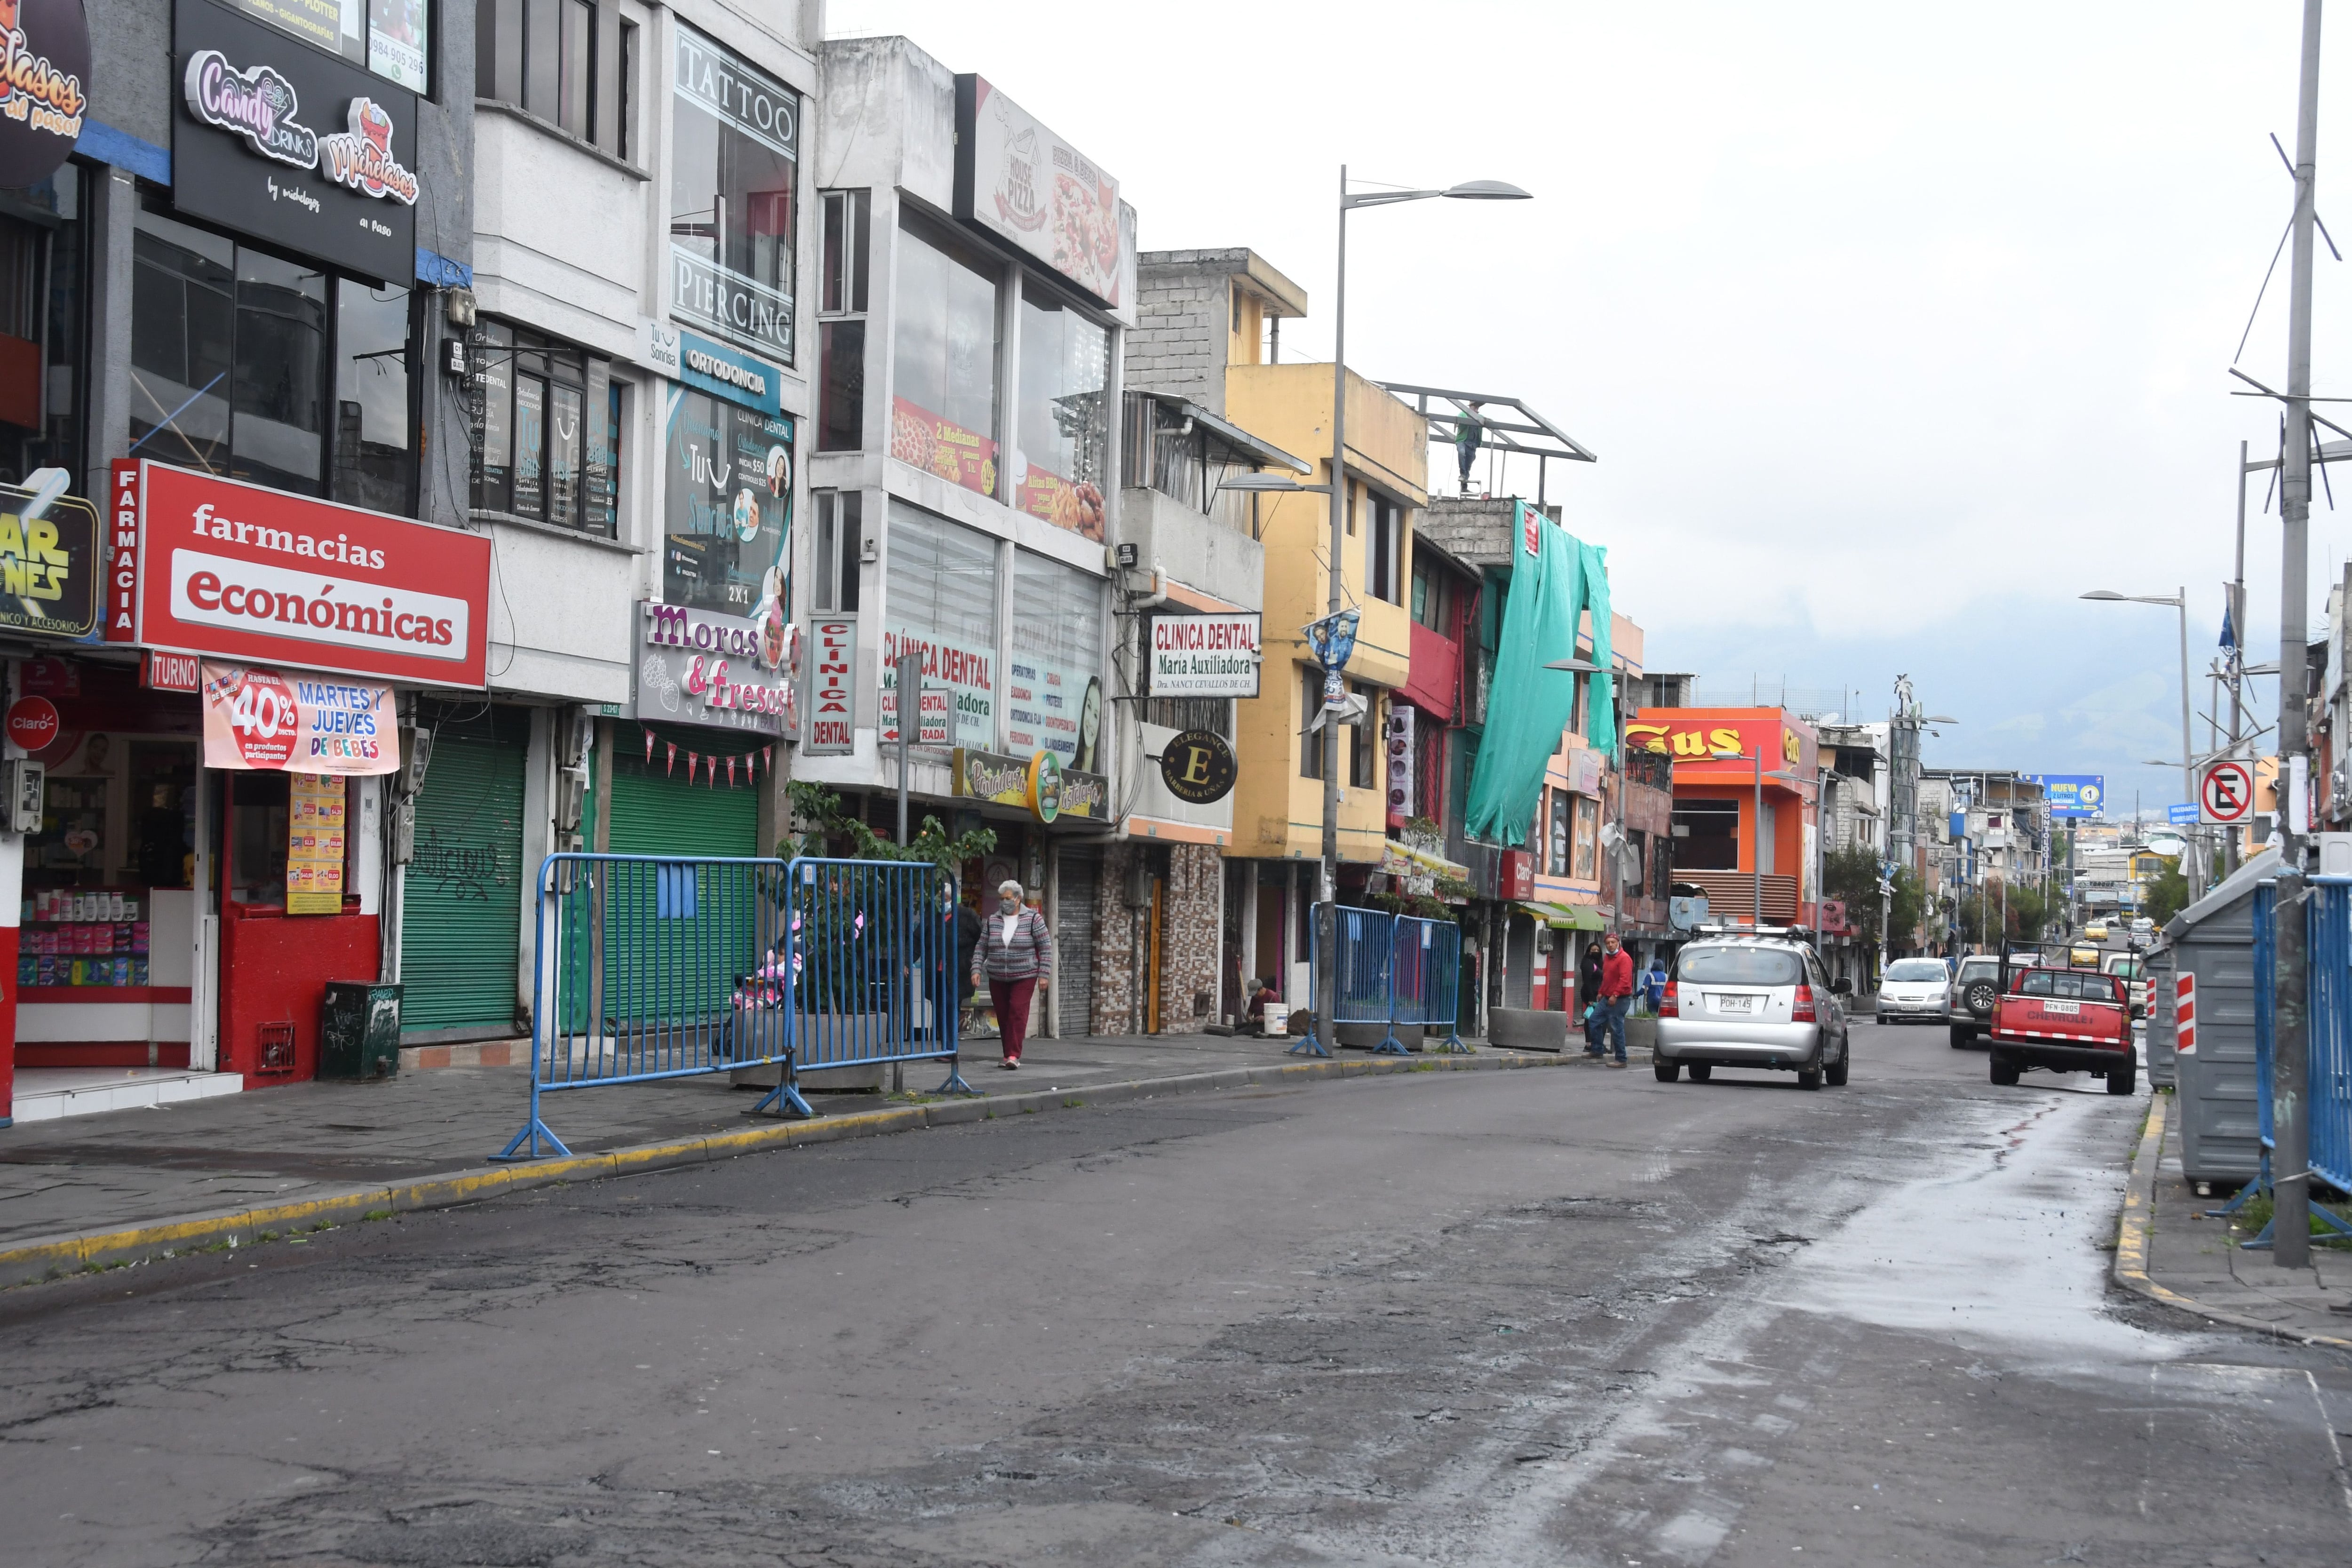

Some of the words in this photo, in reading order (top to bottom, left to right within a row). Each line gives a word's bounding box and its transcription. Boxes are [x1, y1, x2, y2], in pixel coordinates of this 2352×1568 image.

[390, 48, 406, 66] 905
[409, 56, 423, 75] 296
[203, 62, 274, 140] Candy
[681, 38, 792, 141] TATTOO
[271, 126, 312, 158] DRINKS
[330, 136, 416, 200] Michelasos
[1010, 153, 1032, 188] HOUSE
[1053, 145, 1073, 173] PIZZA
[1074, 156, 1079, 177] &
[1080, 160, 1097, 192] BEER
[268, 175, 278, 201] by
[1008, 177, 1035, 216] PIZZA
[678, 261, 790, 345] PIERCING
[651, 323, 660, 343] Tu
[651, 343, 675, 367] Sonrisa
[688, 349, 767, 396] ORTODONCIA
[520, 406, 539, 453] Tu
[765, 418, 789, 438] DENTAL
[937, 422, 942, 440] 2
[944, 426, 980, 448] Medianas
[690, 444, 705, 484] Tu
[739, 457, 752, 469] INICIAL
[753, 459, 764, 474] $50
[738, 472, 758, 486] CONTROLES
[1028, 475, 1045, 489] Alitas
[1045, 477, 1058, 491] BBQ
[688, 492, 733, 540] Sonrisa
[192, 503, 385, 570] farmacias
[116, 471, 136, 629] FARMACIA
[186, 570, 453, 646] económicas
[25, 615, 30, 626] Y
[32, 617, 80, 633] ACCESORIOS
[650, 605, 759, 658] moras
[1156, 623, 1204, 651] CLINICA
[1208, 623, 1255, 651] DENTAL
[154, 656, 196, 687] TURNO
[818, 624, 849, 713] CLÍNICA
[942, 646, 991, 691] DENTAL
[1011, 664, 1036, 681] OPERATORIAS
[1158, 653, 1187, 675] María
[1190, 653, 1250, 675] Auxiliadora
[248, 674, 271, 685] HASTA
[687, 655, 706, 695] &
[711, 660, 785, 716] fresas
[1157, 679, 1169, 688] Dra.
[1170, 679, 1194, 689] NANCY
[1195, 679, 1228, 689] CEVALLOS
[1230, 679, 1240, 689] DE
[1240, 679, 1251, 688] CH.
[212, 693, 220, 701] DE
[297, 682, 372, 711] MARTES
[373, 688, 386, 712] Y
[13, 717, 48, 729] Claro
[278, 728, 296, 737] DSCTO.
[311, 709, 377, 736] JUEVES
[814, 721, 850, 745] DENTAL
[961, 714, 969, 725] DE
[970, 716, 979, 727] CH.
[254, 742, 287, 752] productos
[920, 729, 946, 740] RADA
[1173, 732, 1229, 758] ELEGANCE
[245, 752, 287, 761] participantes
[310, 737, 329, 757] DE
[333, 736, 380, 760] BEBÉS
[1181, 746, 1212, 785] E
[971, 762, 1027, 798] Panadería
[1204, 780, 1225, 797] UÑAS
[2051, 783, 2078, 792] NUEVA
[2215, 774, 2238, 809] E
[1516, 862, 1530, 882] Claro
[2045, 1003, 2078, 1012] PFN-0805
